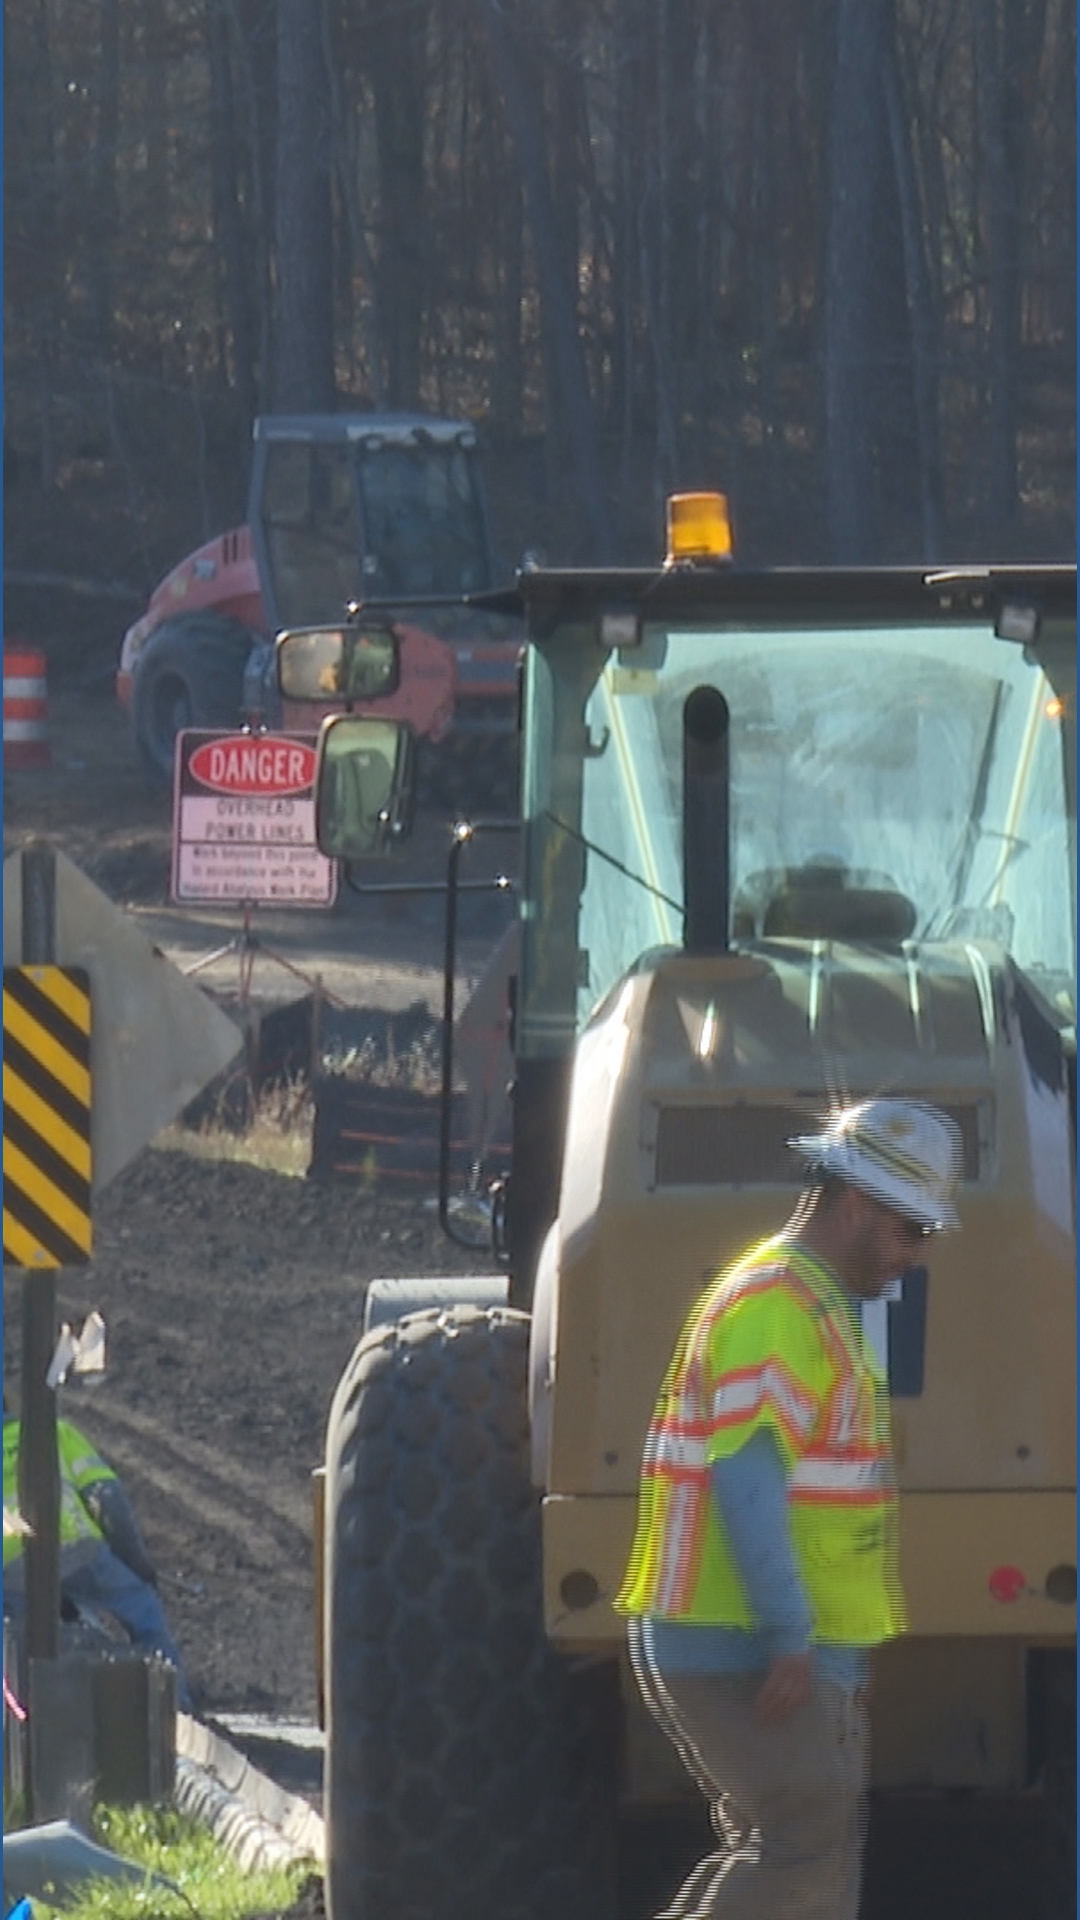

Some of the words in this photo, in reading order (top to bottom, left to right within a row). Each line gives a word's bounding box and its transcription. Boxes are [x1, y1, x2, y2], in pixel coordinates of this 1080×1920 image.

[210, 748, 305, 784] DANGER
[217, 800, 294, 816] OVERHEAD
[206, 822, 255, 838] POWER
[262, 823, 304, 840] LINES
